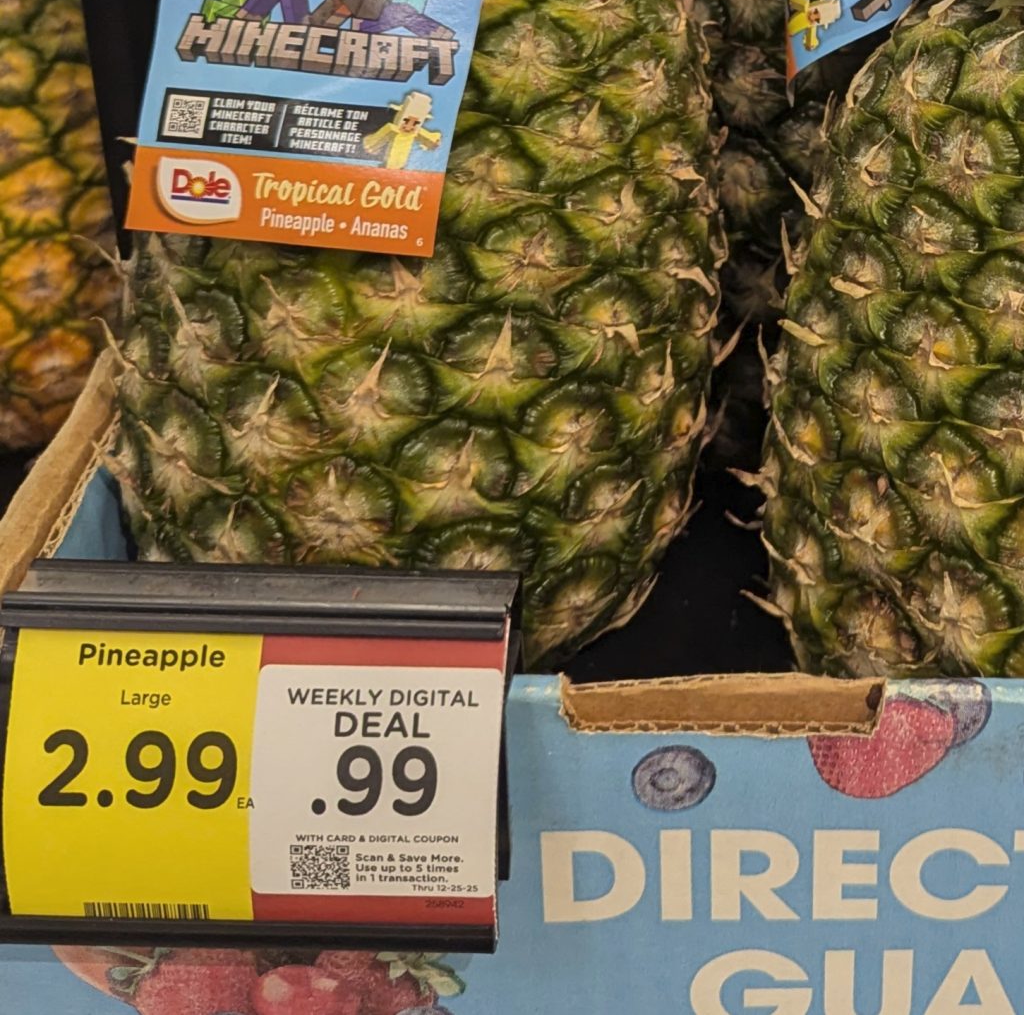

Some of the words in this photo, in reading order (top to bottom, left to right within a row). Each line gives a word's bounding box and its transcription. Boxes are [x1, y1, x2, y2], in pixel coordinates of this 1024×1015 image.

[176, 13, 460, 86] MINECRAFT
[213, 97, 245, 109] CLAIM
[246, 101, 276, 112] YOUR
[293, 103, 344, 118] RÉCLAME
[346, 110, 369, 121] TON
[211, 109, 273, 123] MINECRAFT
[297, 117, 341, 130] ARTICLE
[344, 121, 359, 131] DE
[208, 121, 269, 134] CHARACTER
[289, 127, 362, 143] PERSONNAGE
[221, 133, 253, 145] ITEM!
[289, 138, 356, 154] MINECRAFT!
[171, 168, 232, 198] Dole
[252, 172, 355, 206] Tropical
[360, 180, 423, 212] Gold
[260, 207, 334, 237] Pineapple
[351, 216, 409, 240] Ananas
[416, 237, 424, 247] 6
[78, 643, 226, 672] Pineapple
[120, 689, 172, 709] Large
[288, 688, 382, 707] WEEKLY
[390, 689, 479, 708] DIGITAL
[334, 712, 431, 739] DEAL
[38, 729, 238, 810] 2.99
[237, 797, 255, 810] EA
[311, 745, 438, 817] .99
[296, 834, 324, 843] WITH
[327, 834, 356, 843] CARD
[359, 834, 366, 843] &
[369, 835, 411, 843] DIGITAL
[412, 835, 459, 844] COUPON
[355, 853, 384, 863] Scan
[387, 853, 395, 863] &
[399, 854, 427, 863] Save
[431, 854, 464, 863] More.
[355, 864, 378, 873] Use
[381, 865, 396, 875] up
[400, 864, 412, 873] to
[416, 864, 423, 873] 5
[427, 864, 459, 874] times
[356, 874, 367, 883] in
[379, 874, 449, 884] transaction.
[412, 884, 434, 892] Thru
[437, 884, 479, 893] 12-25-25
